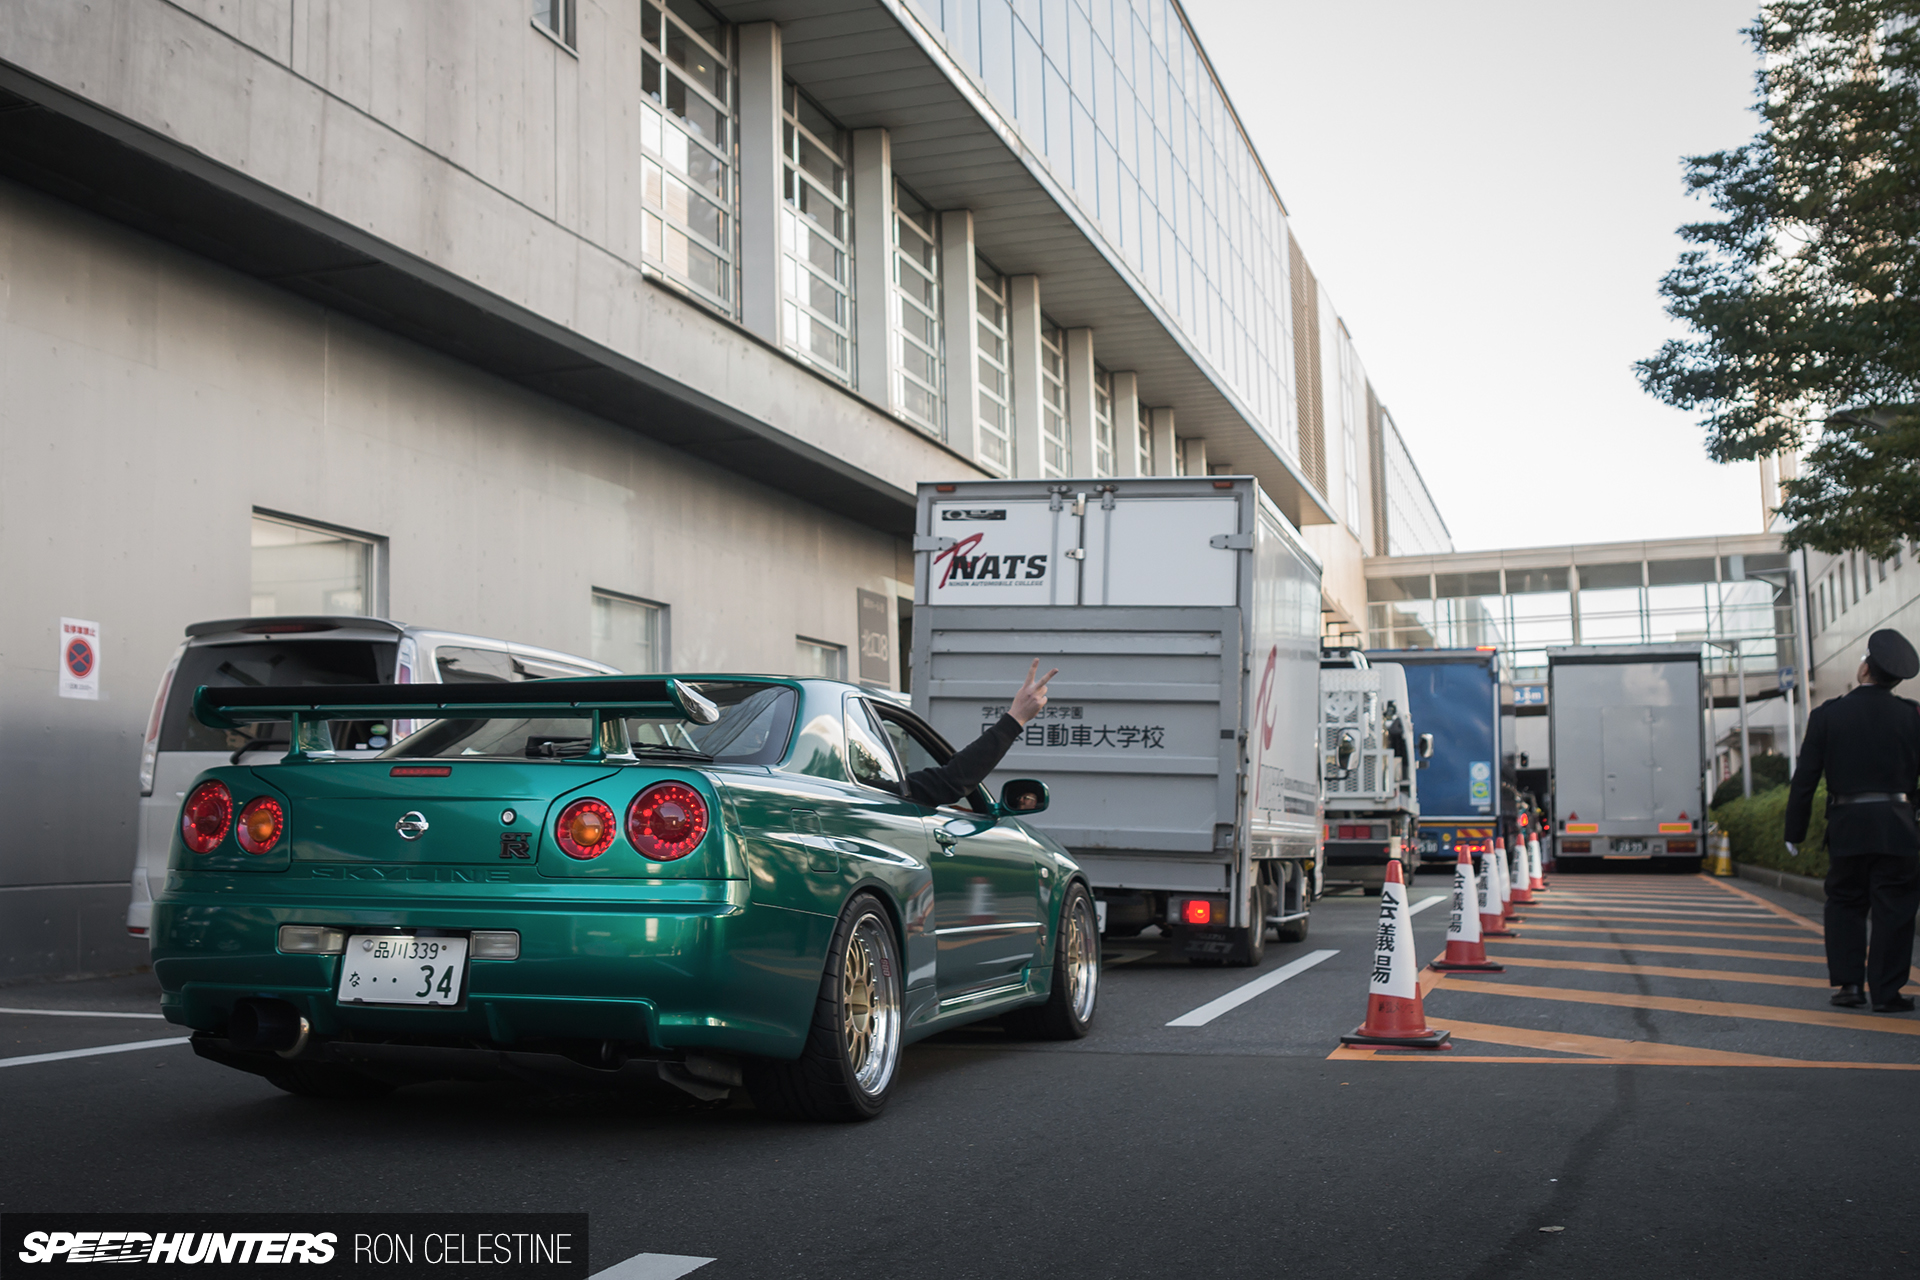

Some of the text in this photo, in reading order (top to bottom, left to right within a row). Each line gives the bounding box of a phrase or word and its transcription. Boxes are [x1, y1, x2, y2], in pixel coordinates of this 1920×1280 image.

[949, 555, 1048, 579] NATS
[311, 867, 511, 883] SKYLINE
[415, 965, 454, 999] 34
